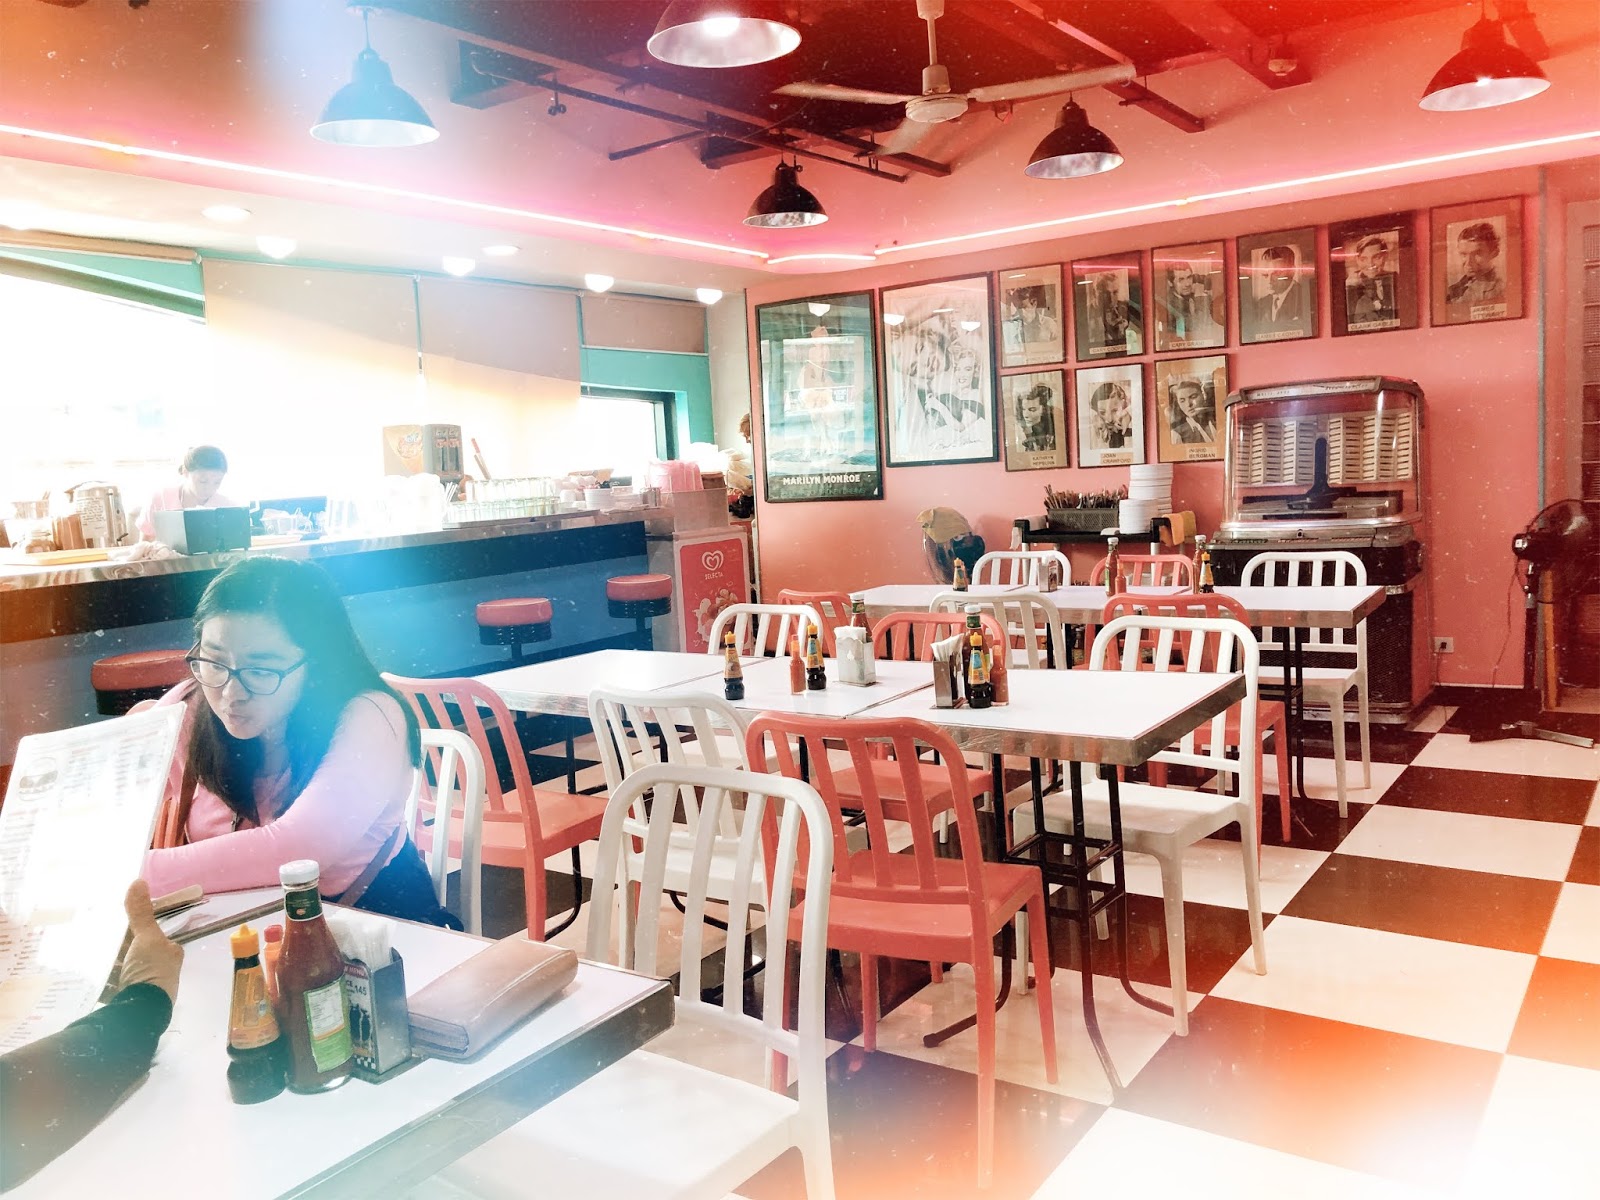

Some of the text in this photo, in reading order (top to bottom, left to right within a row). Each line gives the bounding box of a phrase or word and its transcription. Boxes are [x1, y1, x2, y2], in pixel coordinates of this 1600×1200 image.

[782, 474, 861, 486] MARILYN MONROE
[704, 571, 724, 580] SELECTA
